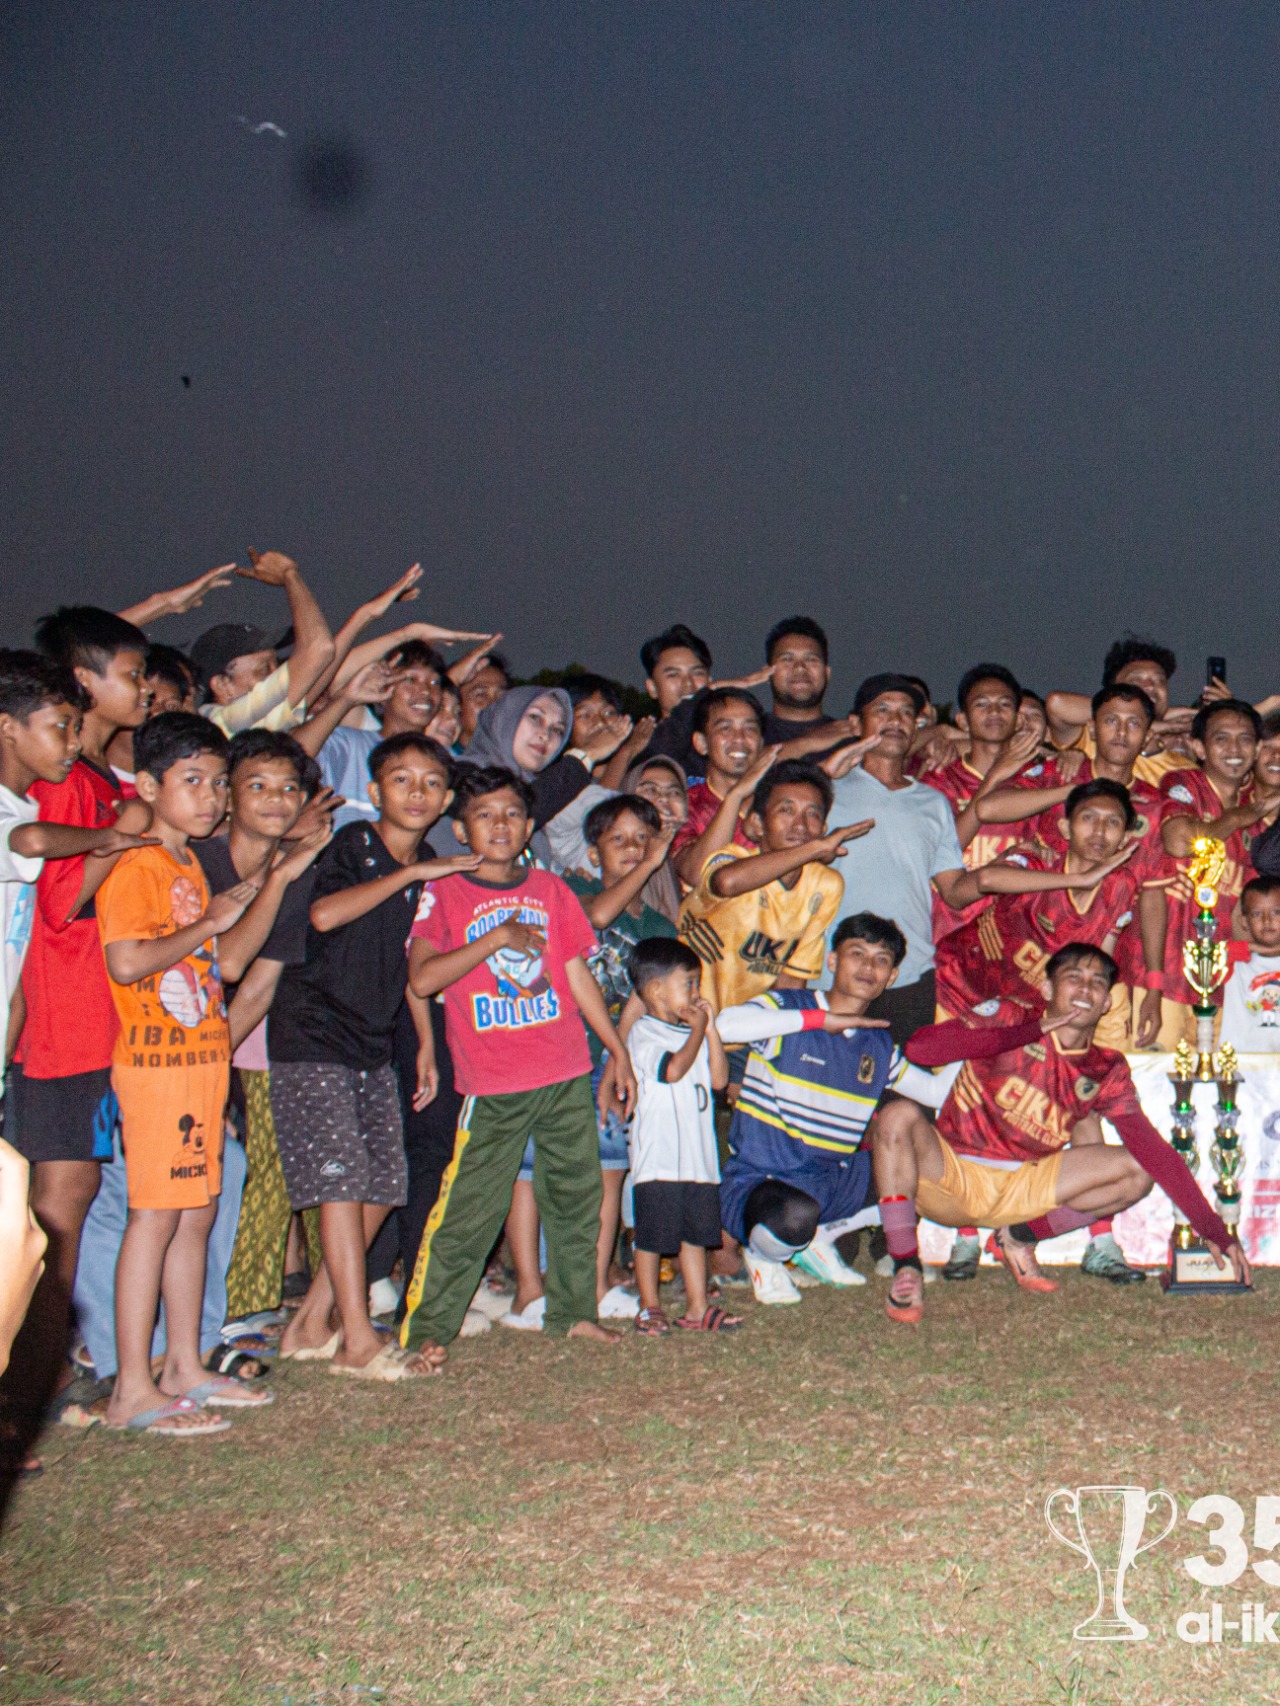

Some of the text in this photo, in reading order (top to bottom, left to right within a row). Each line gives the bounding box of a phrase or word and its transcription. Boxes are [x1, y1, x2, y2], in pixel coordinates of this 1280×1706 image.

[473, 896, 545, 915] ATLANTIC CITY
[475, 987, 558, 1029] BULLIES
